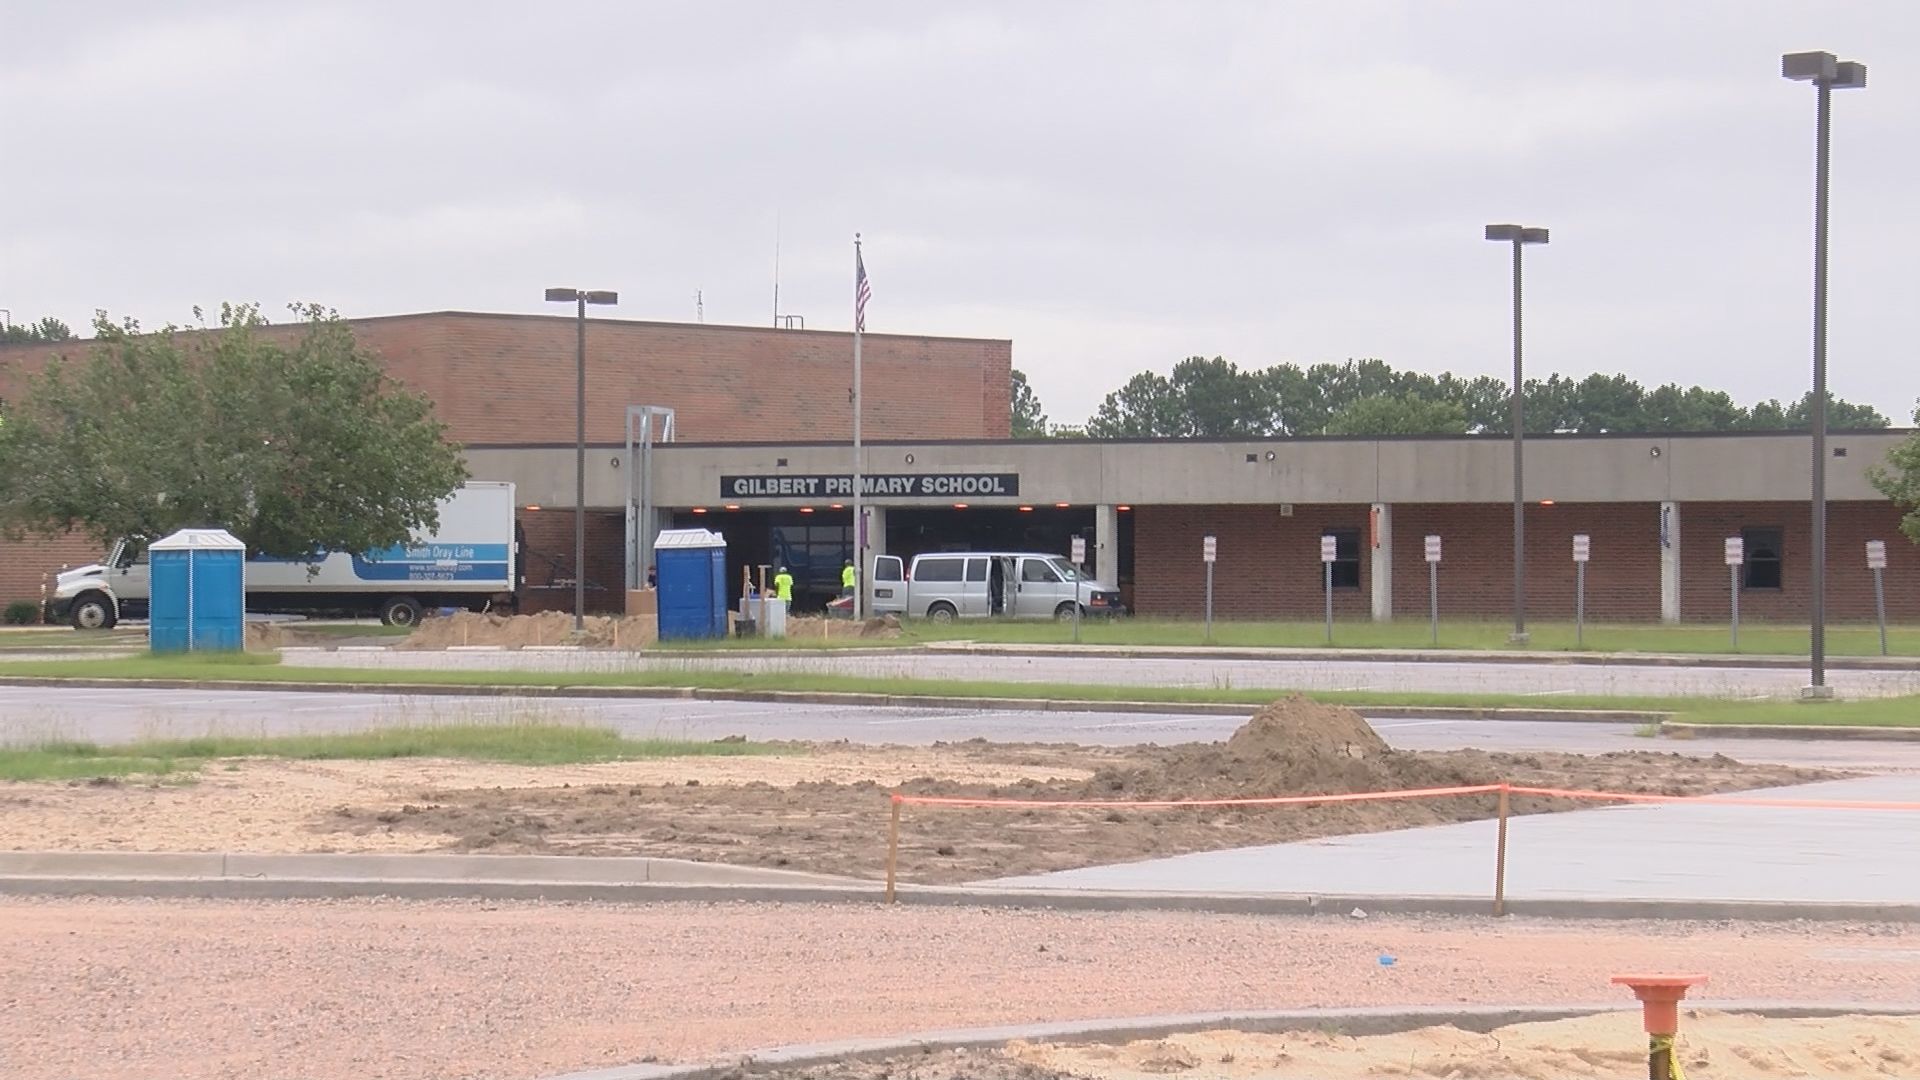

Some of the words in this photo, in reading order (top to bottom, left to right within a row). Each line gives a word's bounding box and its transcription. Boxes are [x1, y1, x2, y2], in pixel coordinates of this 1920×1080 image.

[734, 478, 818, 494] GILBERT
[921, 477, 1005, 493] SCHOOL
[433, 546, 453, 560] Dray
[454, 545, 474, 558] Line
